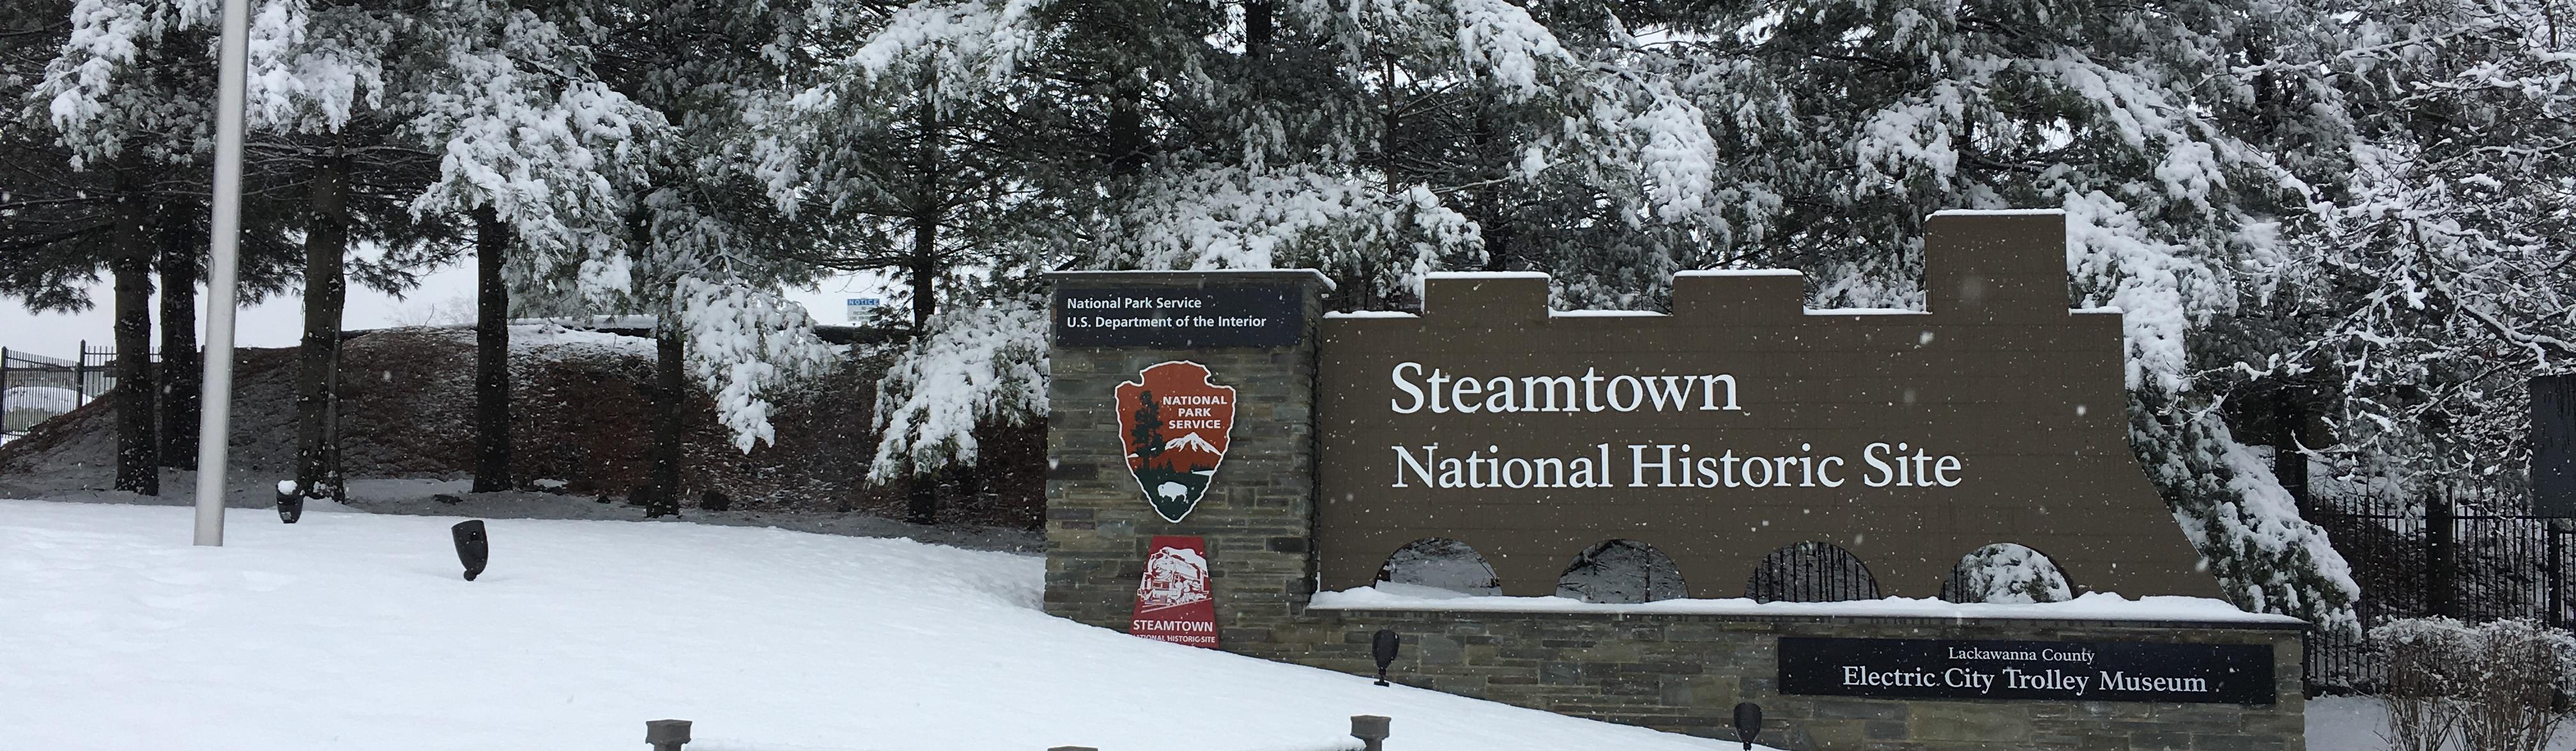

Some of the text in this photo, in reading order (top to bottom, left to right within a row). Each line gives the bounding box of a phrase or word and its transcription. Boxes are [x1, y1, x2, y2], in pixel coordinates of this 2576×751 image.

[1067, 297, 1202, 309] National Park Service
[1067, 316, 1267, 330] U.S. Department of the Interior
[1391, 362, 1742, 414] Steamtown
[1163, 396, 1228, 405] NATIONAL
[1178, 408, 1211, 417] PARK
[1169, 419, 1221, 430] SERVICE
[1391, 442, 1963, 489] National Historic Site
[1133, 619, 1213, 632] STEAMTOWN
[1948, 647, 2095, 665] Lackawanna County
[1842, 665, 2207, 696] Electric City Trolley Museum
